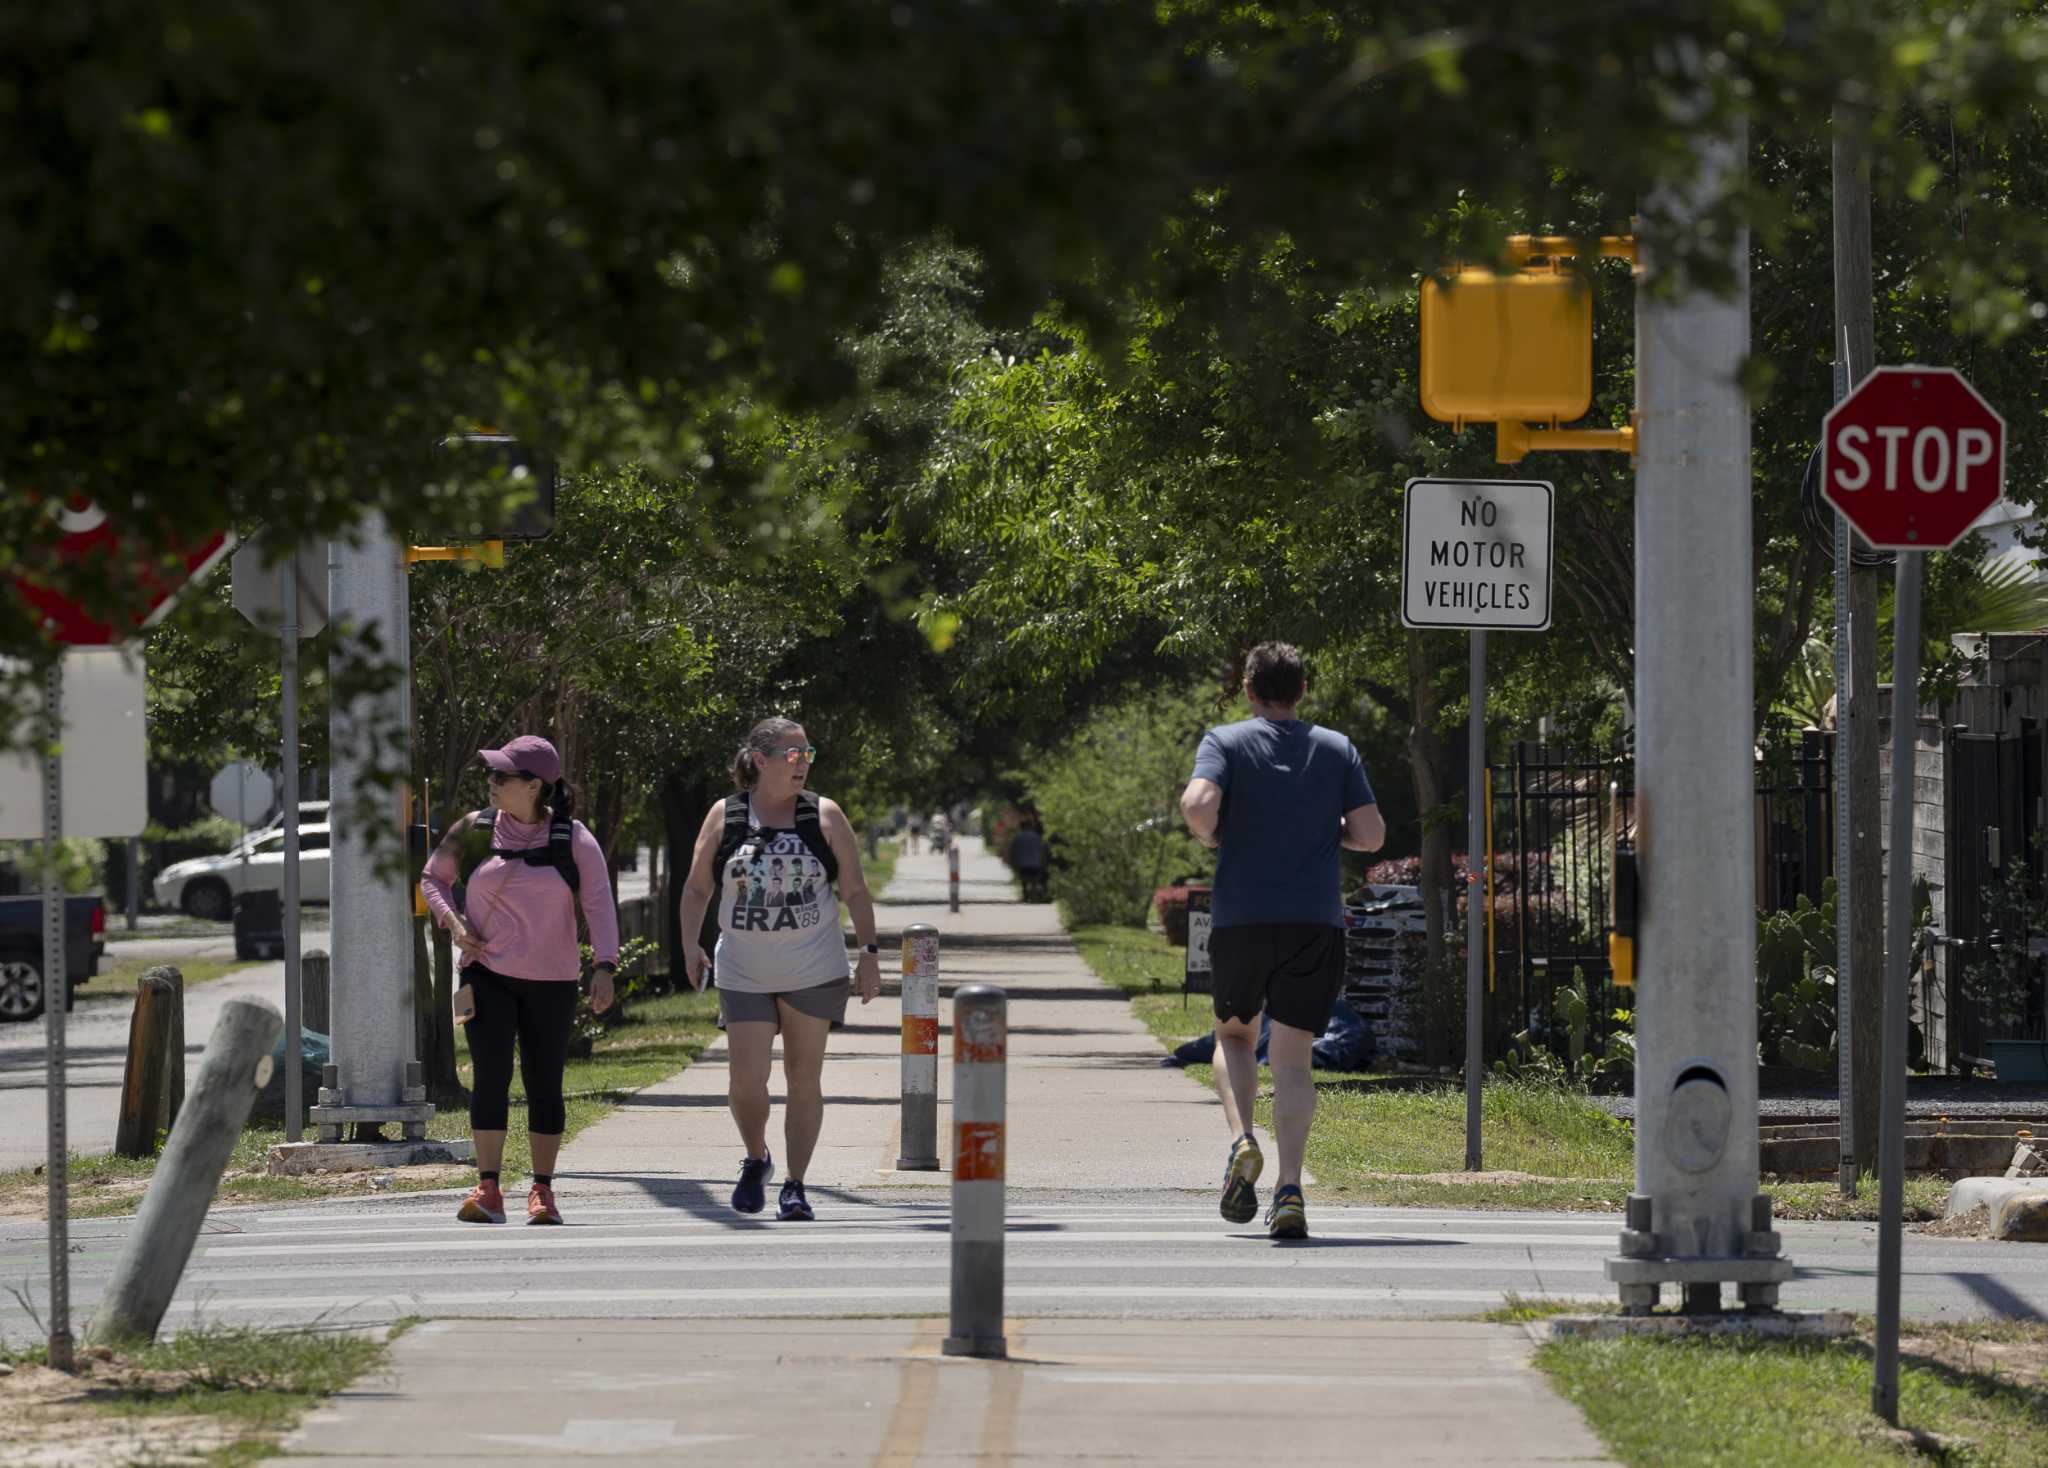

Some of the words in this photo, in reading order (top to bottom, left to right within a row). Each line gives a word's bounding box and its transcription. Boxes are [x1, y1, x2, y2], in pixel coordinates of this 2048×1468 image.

[1834, 425, 1994, 493] STOP
[1461, 500, 1496, 526] NO
[1431, 541, 1525, 568] MOTOR
[1425, 581, 1530, 609] VEHICLES
[731, 906, 799, 931] ERA
